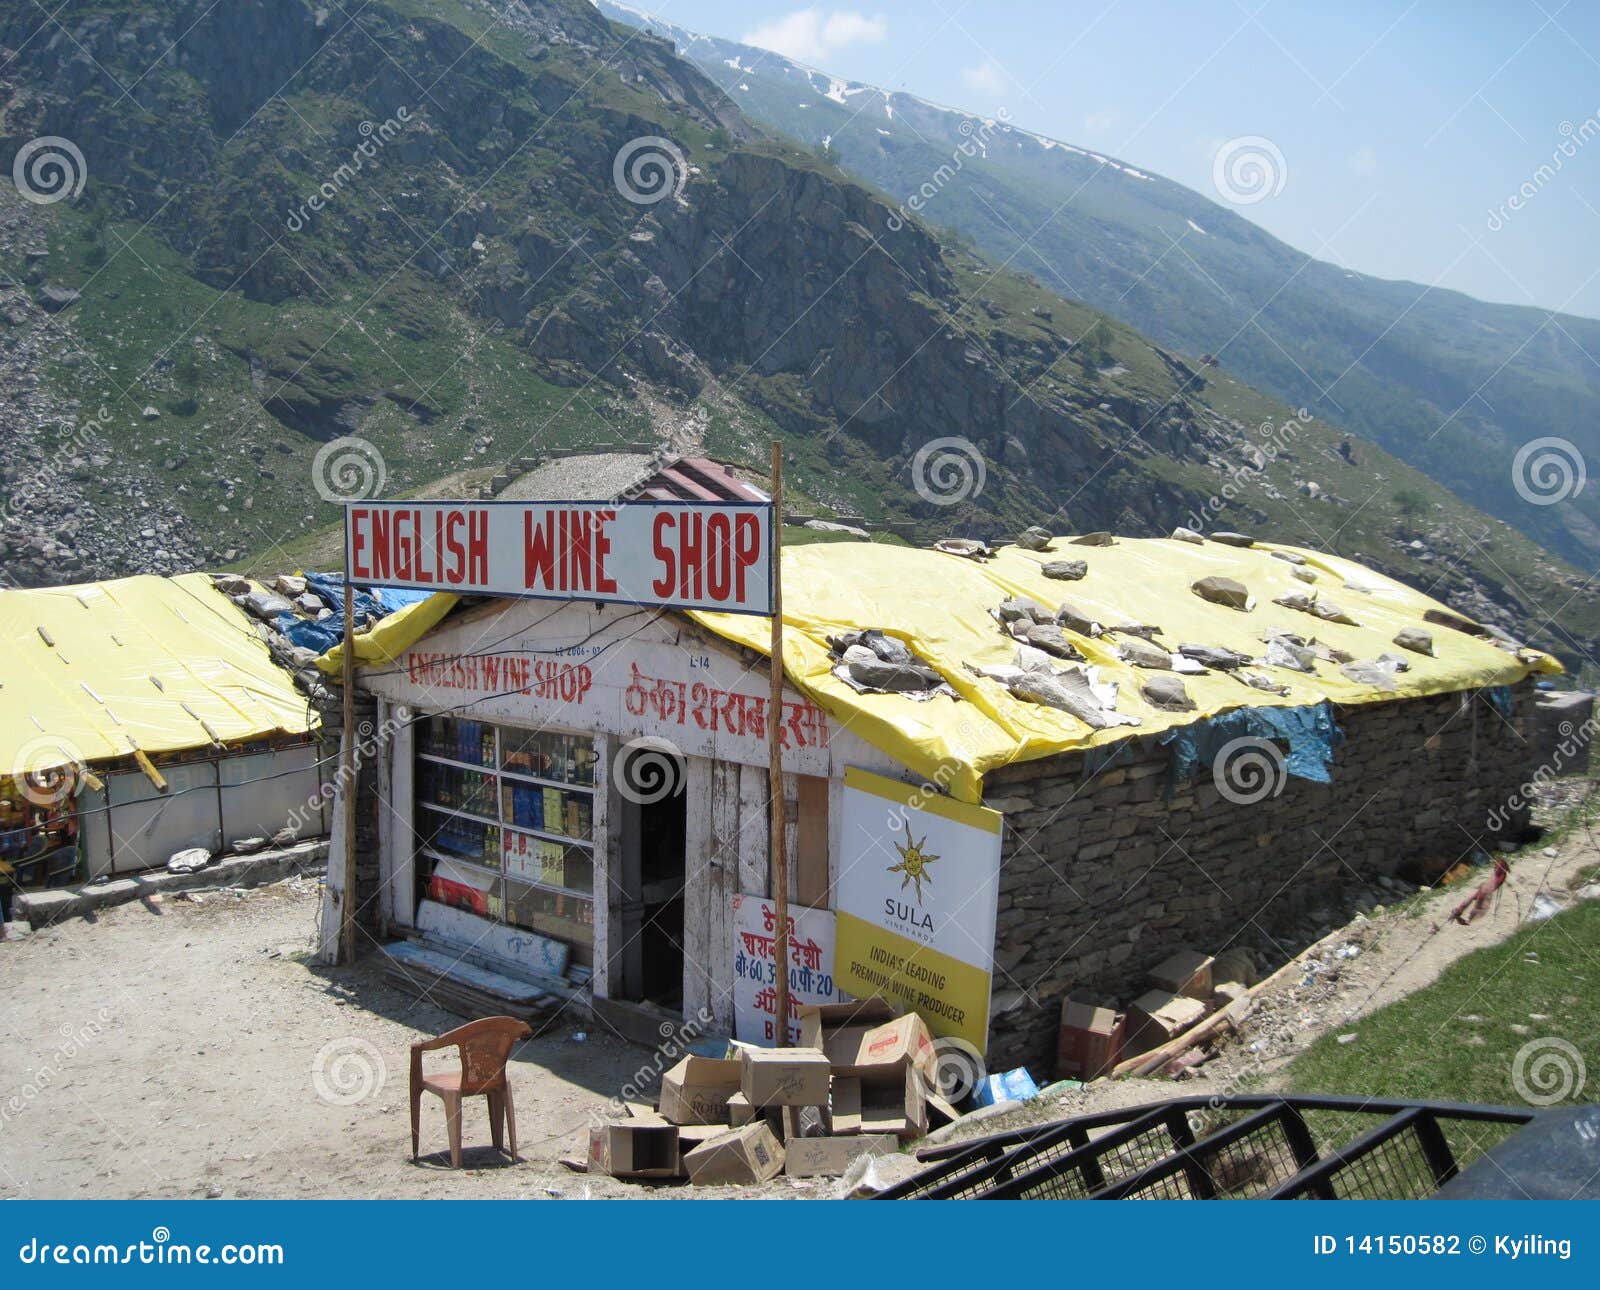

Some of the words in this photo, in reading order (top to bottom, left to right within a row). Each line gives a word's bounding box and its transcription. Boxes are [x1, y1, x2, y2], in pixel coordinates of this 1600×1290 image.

[351, 509, 489, 586] ENGLISH
[524, 509, 617, 594] WINE
[652, 511, 761, 604] SHOP
[408, 652, 479, 691] ENGLISH
[480, 655, 532, 696] WINE
[534, 660, 593, 705] SHOP
[885, 898, 935, 933] SULA
[849, 960, 890, 990] PREMIUM
[891, 979, 918, 1002] WINE
[917, 991, 966, 1027] PRODUCER
[869, 945, 905, 973] INDIA'S
[905, 960, 947, 991] LEADING
